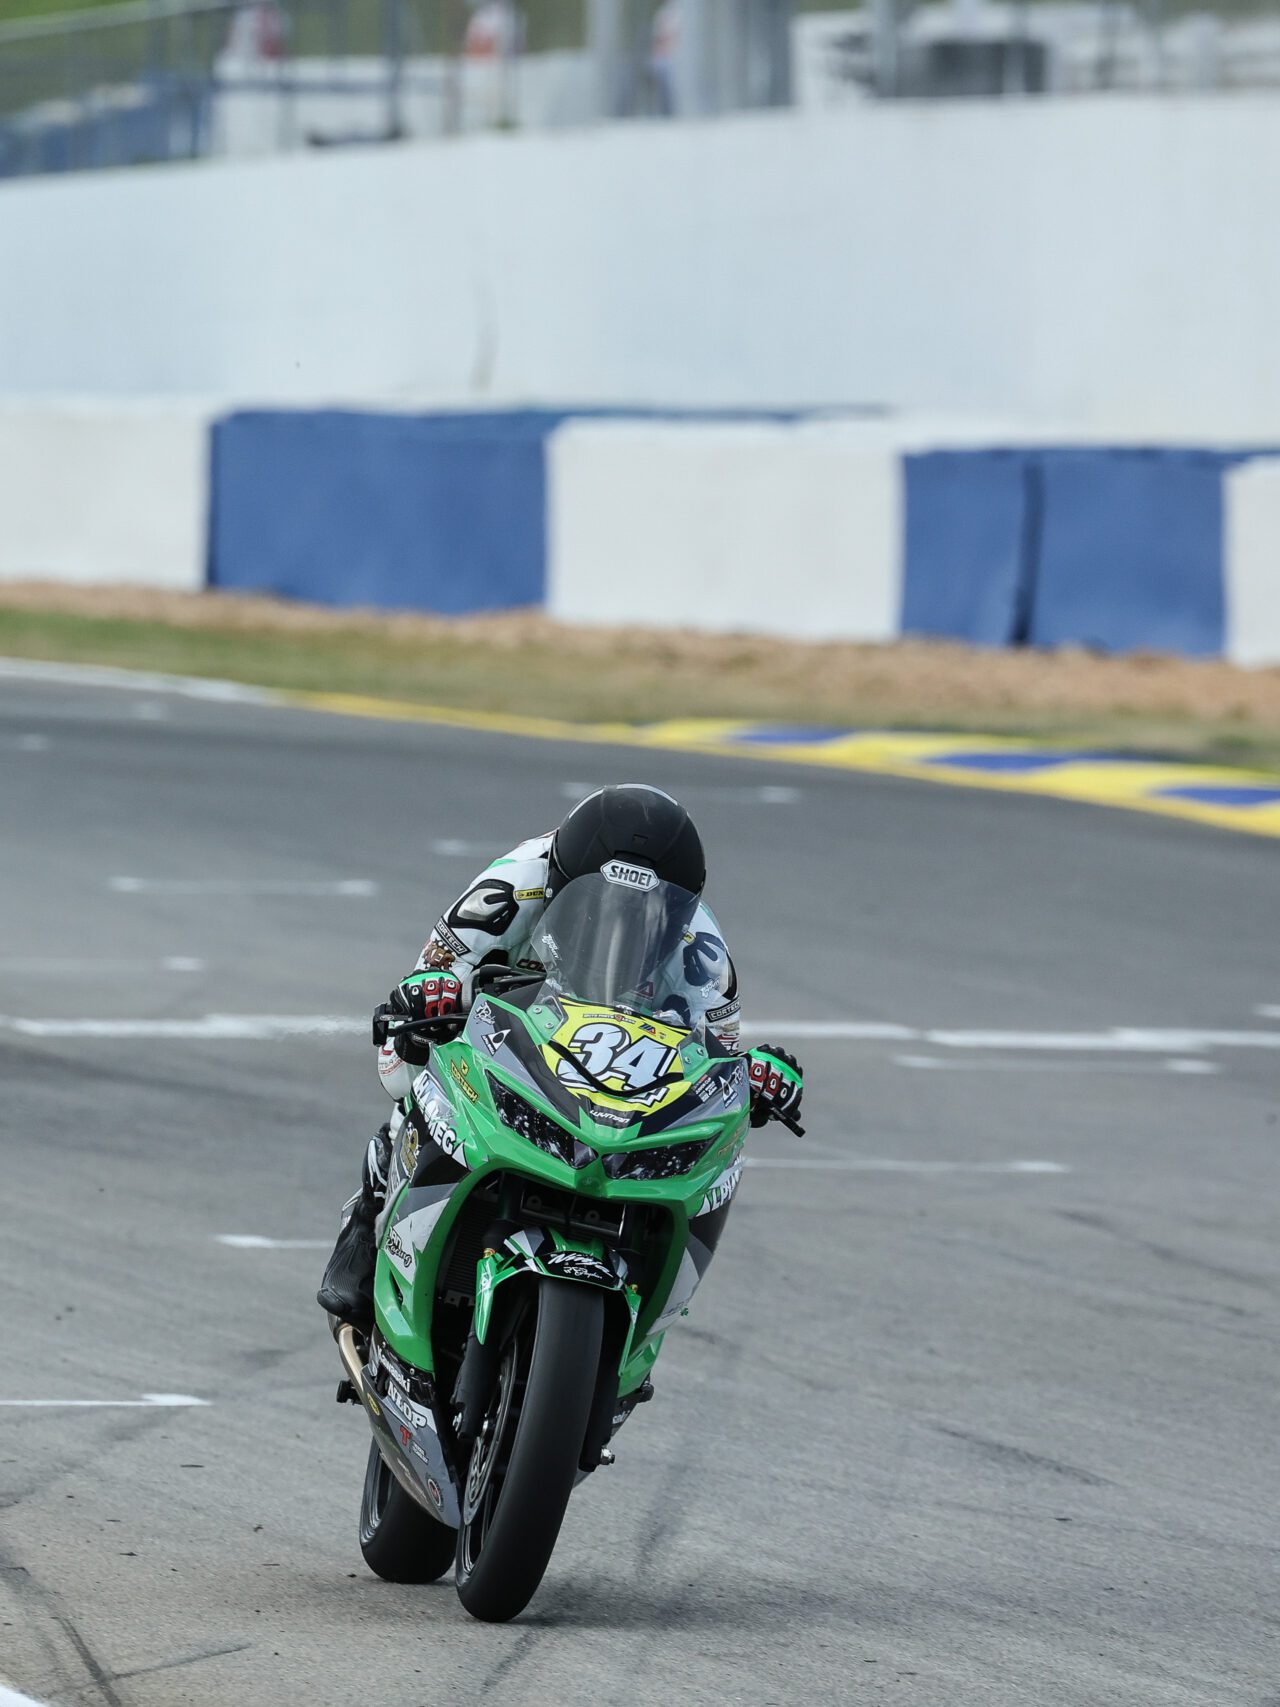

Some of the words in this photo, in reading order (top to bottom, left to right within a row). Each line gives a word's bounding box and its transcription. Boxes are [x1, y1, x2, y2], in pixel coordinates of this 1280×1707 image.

[609, 864, 652, 887] SHOEI
[436, 921, 467, 954] CORTECH
[557, 1022, 677, 1107] 34
